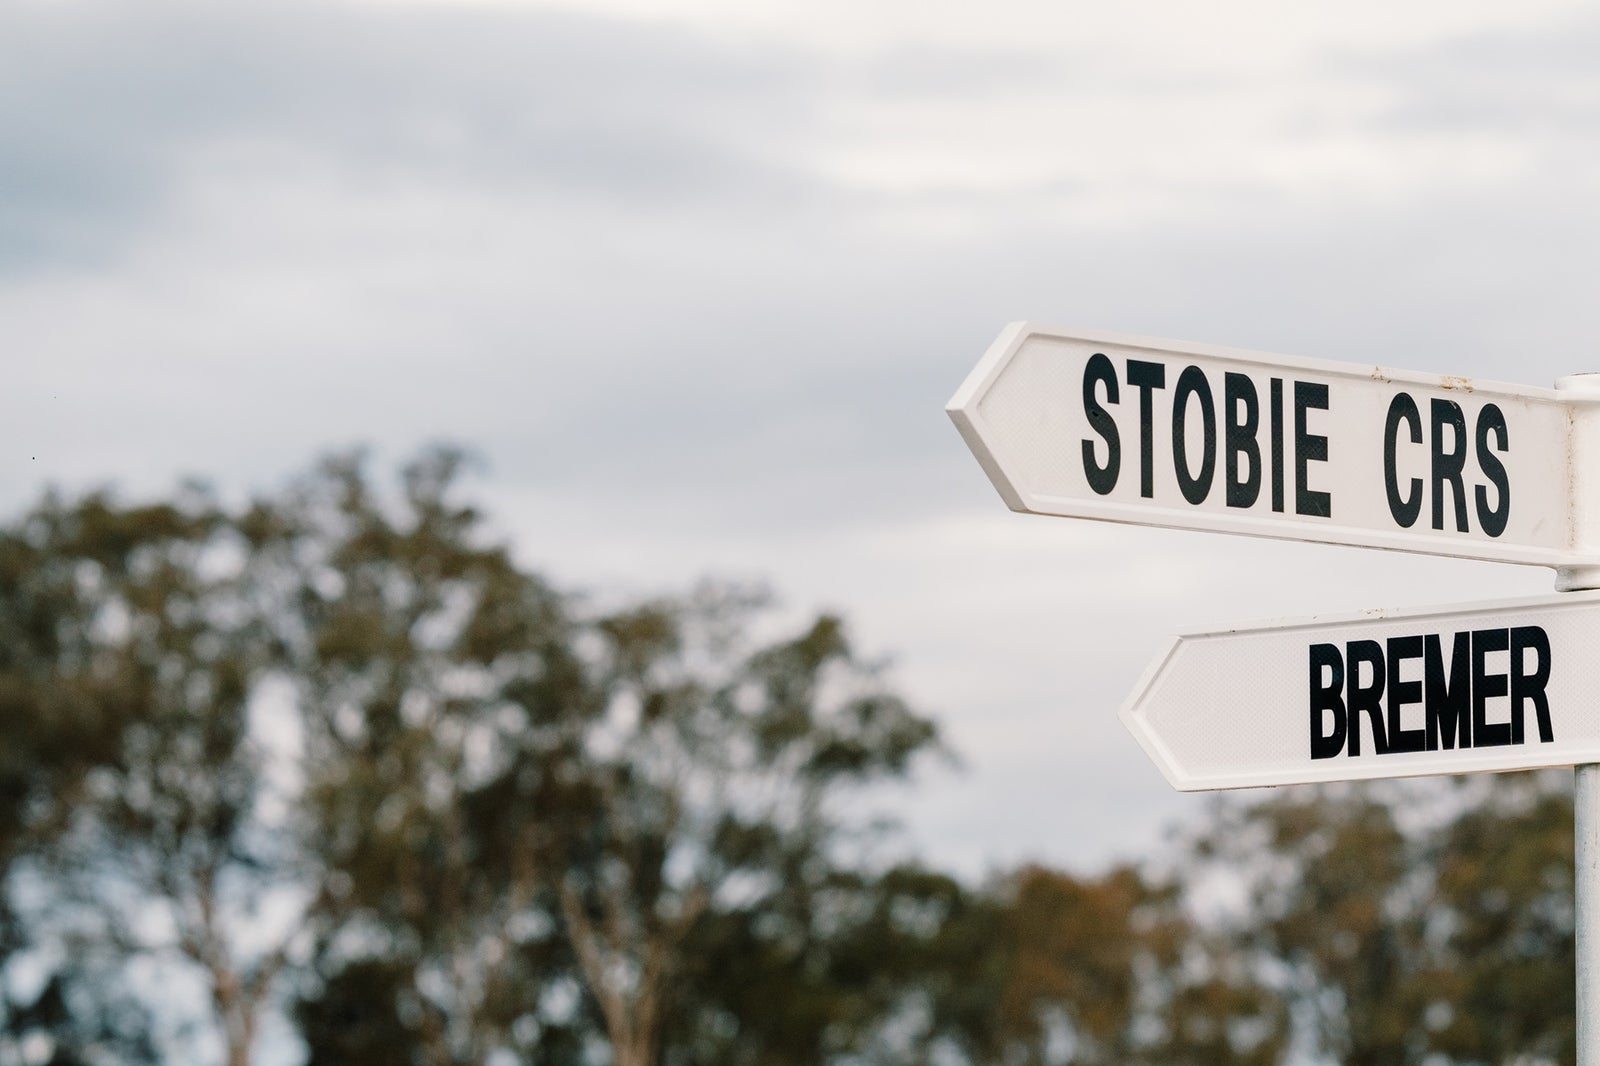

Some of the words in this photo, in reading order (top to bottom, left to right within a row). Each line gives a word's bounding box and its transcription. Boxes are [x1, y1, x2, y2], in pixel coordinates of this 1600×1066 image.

[1082, 353, 1332, 519] STOBIE
[1384, 393, 1510, 538] CRS
[1309, 625, 1555, 760] BREMER
